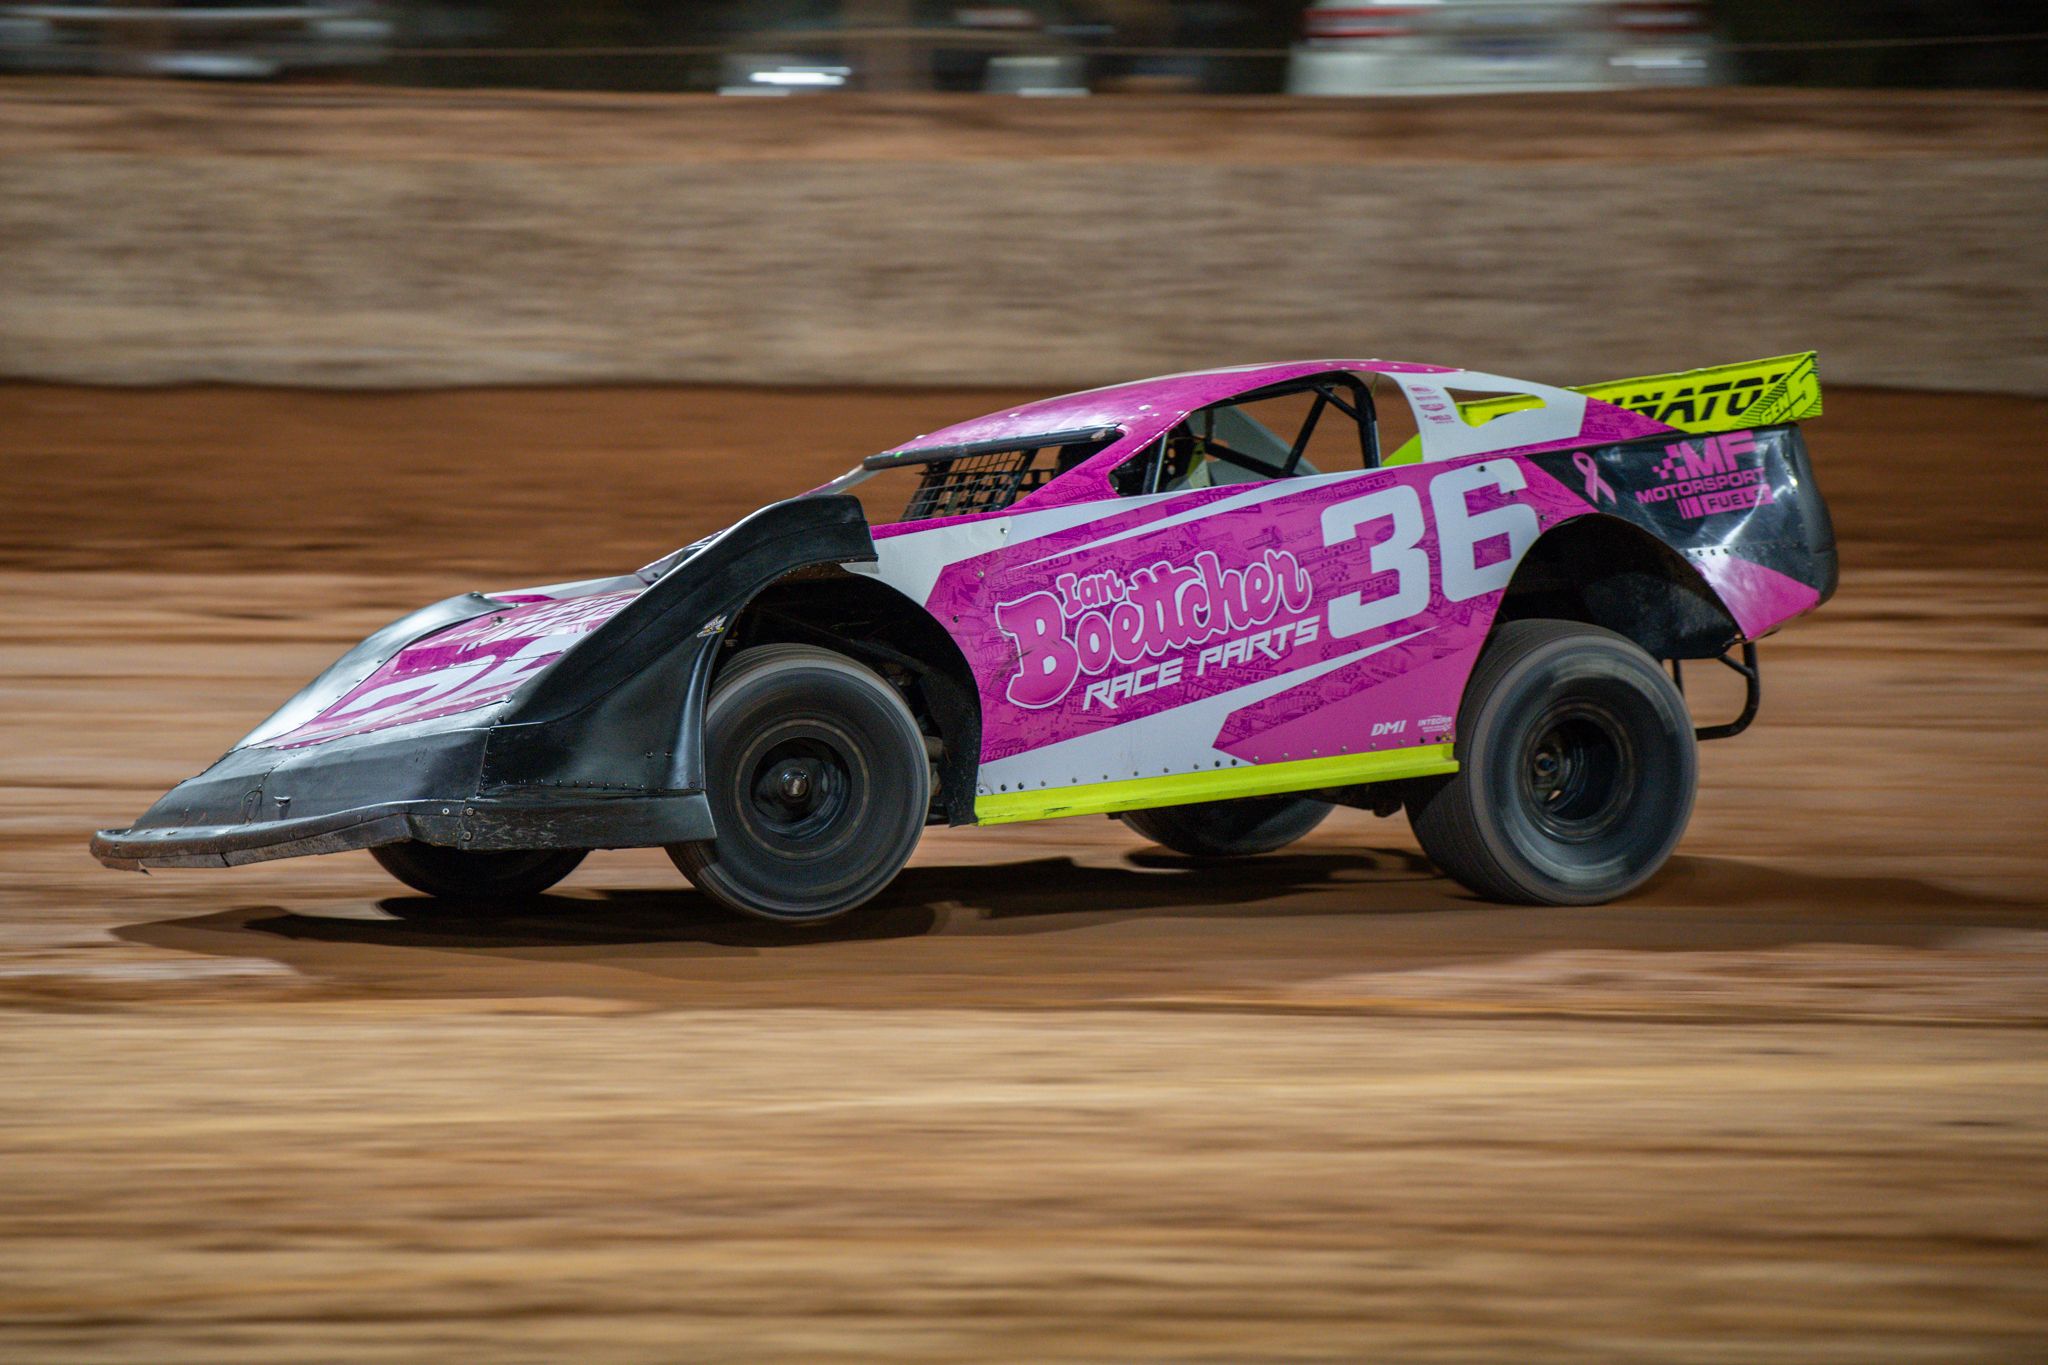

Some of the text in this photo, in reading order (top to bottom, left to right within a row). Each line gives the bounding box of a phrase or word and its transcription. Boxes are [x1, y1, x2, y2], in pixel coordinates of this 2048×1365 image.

[1678, 430, 1757, 479] MF
[1634, 467, 1766, 505] MOTORSPORT
[1321, 456, 1541, 639] 36
[1056, 569, 1126, 619] Ian
[995, 548, 1313, 710] Boettcher
[1082, 656, 1184, 711] RACE
[1196, 614, 1321, 677] PARTS
[1370, 719, 1407, 737] DMI
